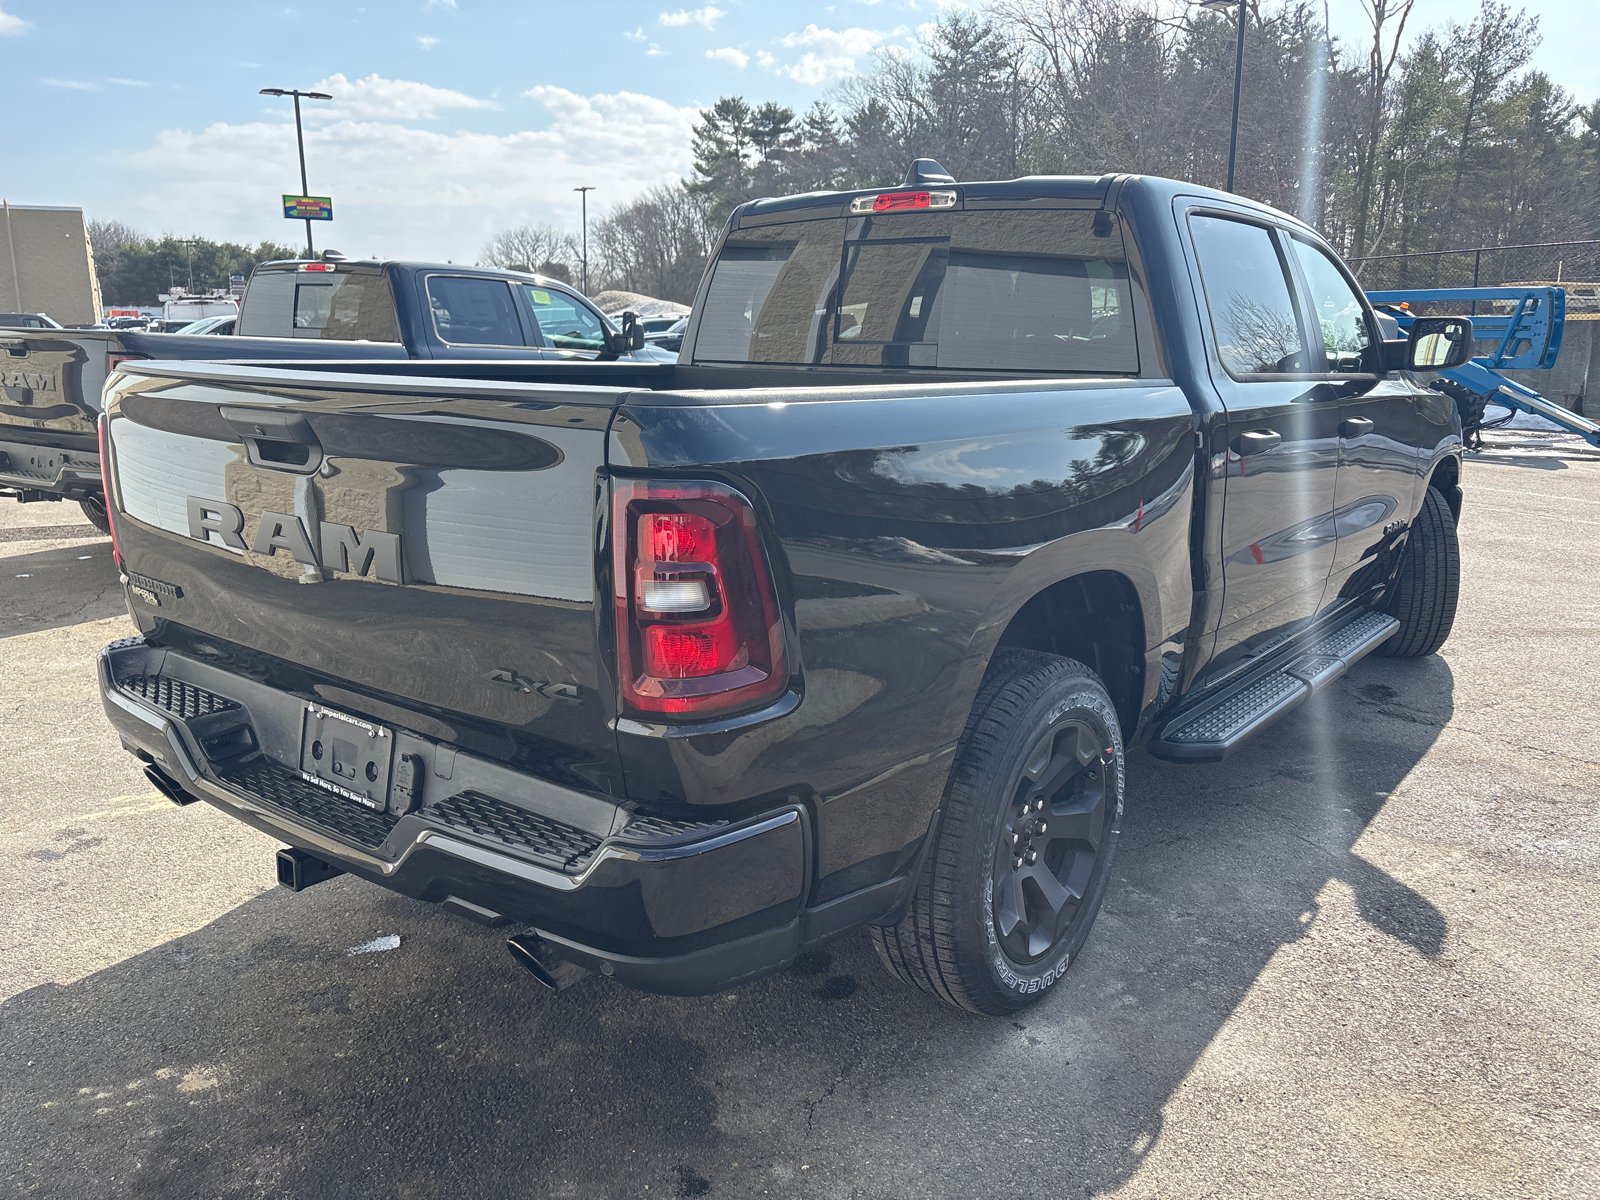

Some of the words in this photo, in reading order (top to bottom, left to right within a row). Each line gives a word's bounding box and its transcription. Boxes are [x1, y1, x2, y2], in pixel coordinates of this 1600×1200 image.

[187, 494, 404, 584] RAM
[302, 772, 310, 780] We
[310, 775, 319, 785] Sell
[332, 785, 340, 794] So
[340, 788, 350, 798] You
[350, 792, 362, 804] Save
[362, 796, 376, 809] More
[994, 953, 1070, 994] DUELER
